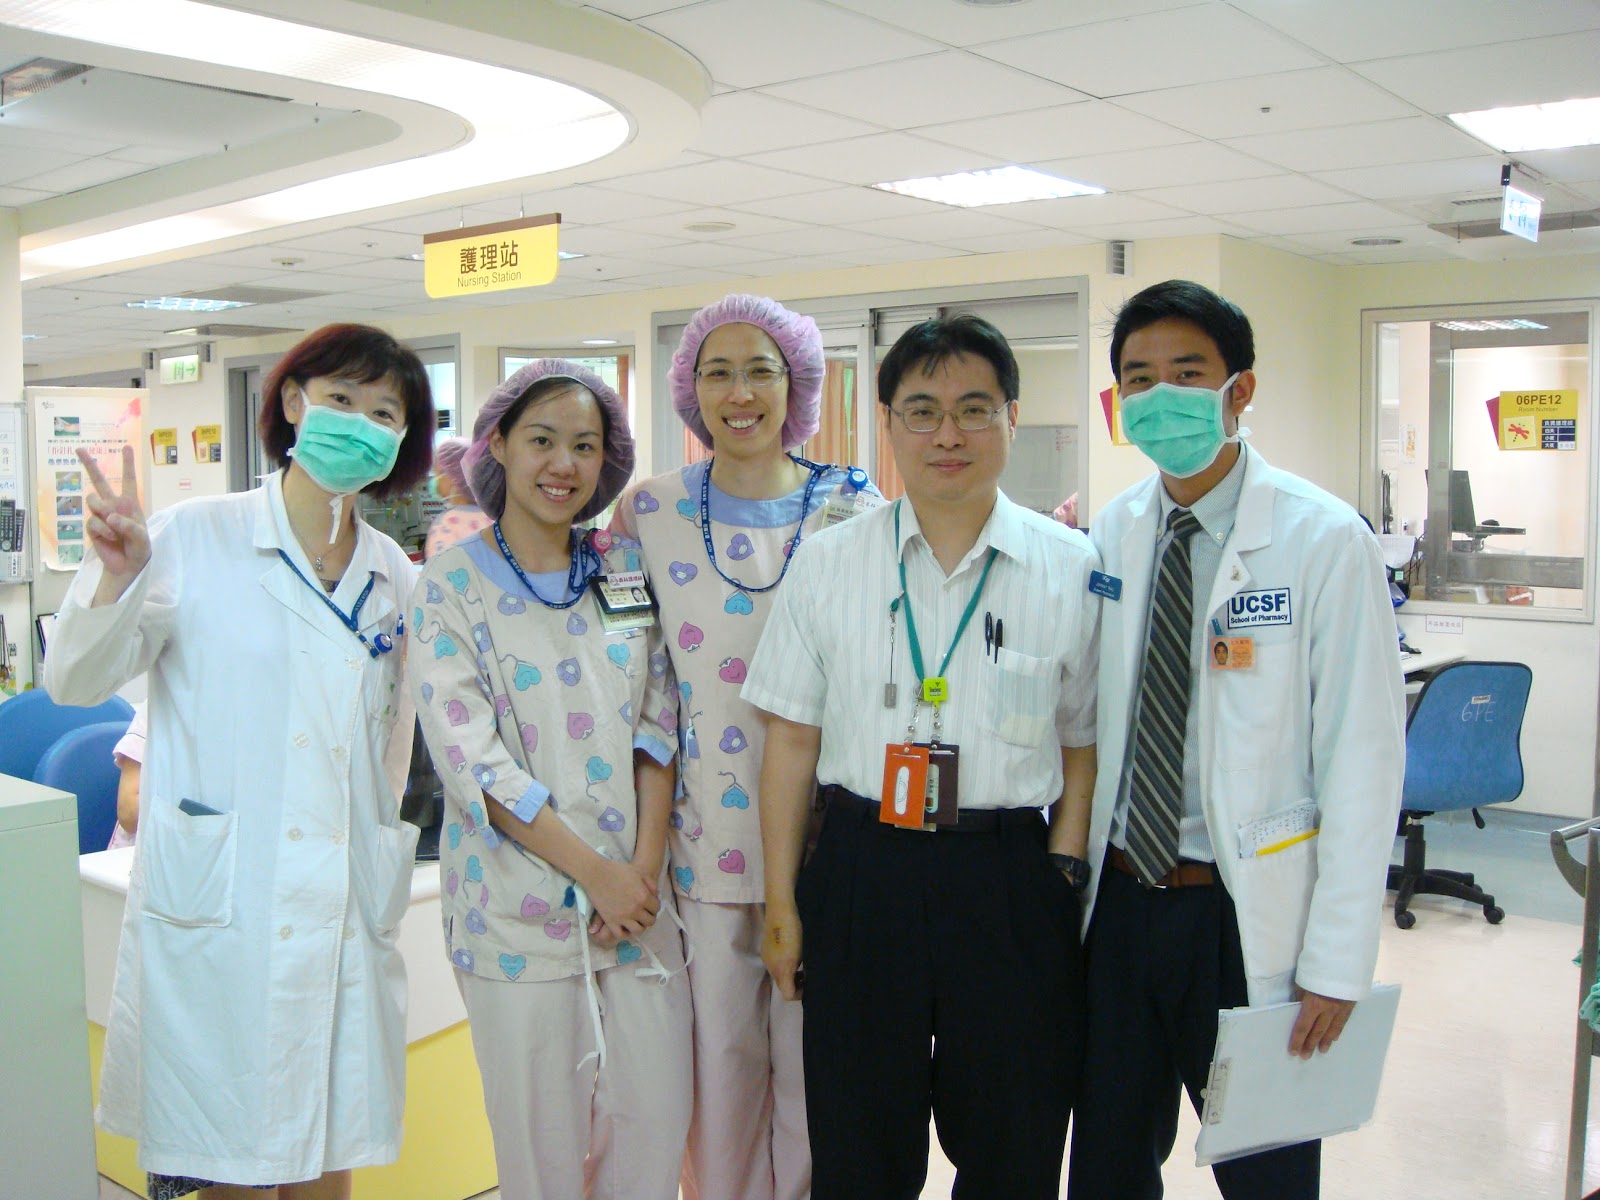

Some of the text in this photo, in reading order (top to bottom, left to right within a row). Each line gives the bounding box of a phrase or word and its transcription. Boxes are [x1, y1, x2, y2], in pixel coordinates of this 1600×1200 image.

[460, 240, 519, 274] 護理站
[457, 271, 521, 288] Nursing Station
[1516, 394, 1562, 405] 06PE12
[1231, 593, 1287, 615] UCSF
[1230, 616, 1250, 624] School
[1258, 614, 1288, 622] Pharmacy
